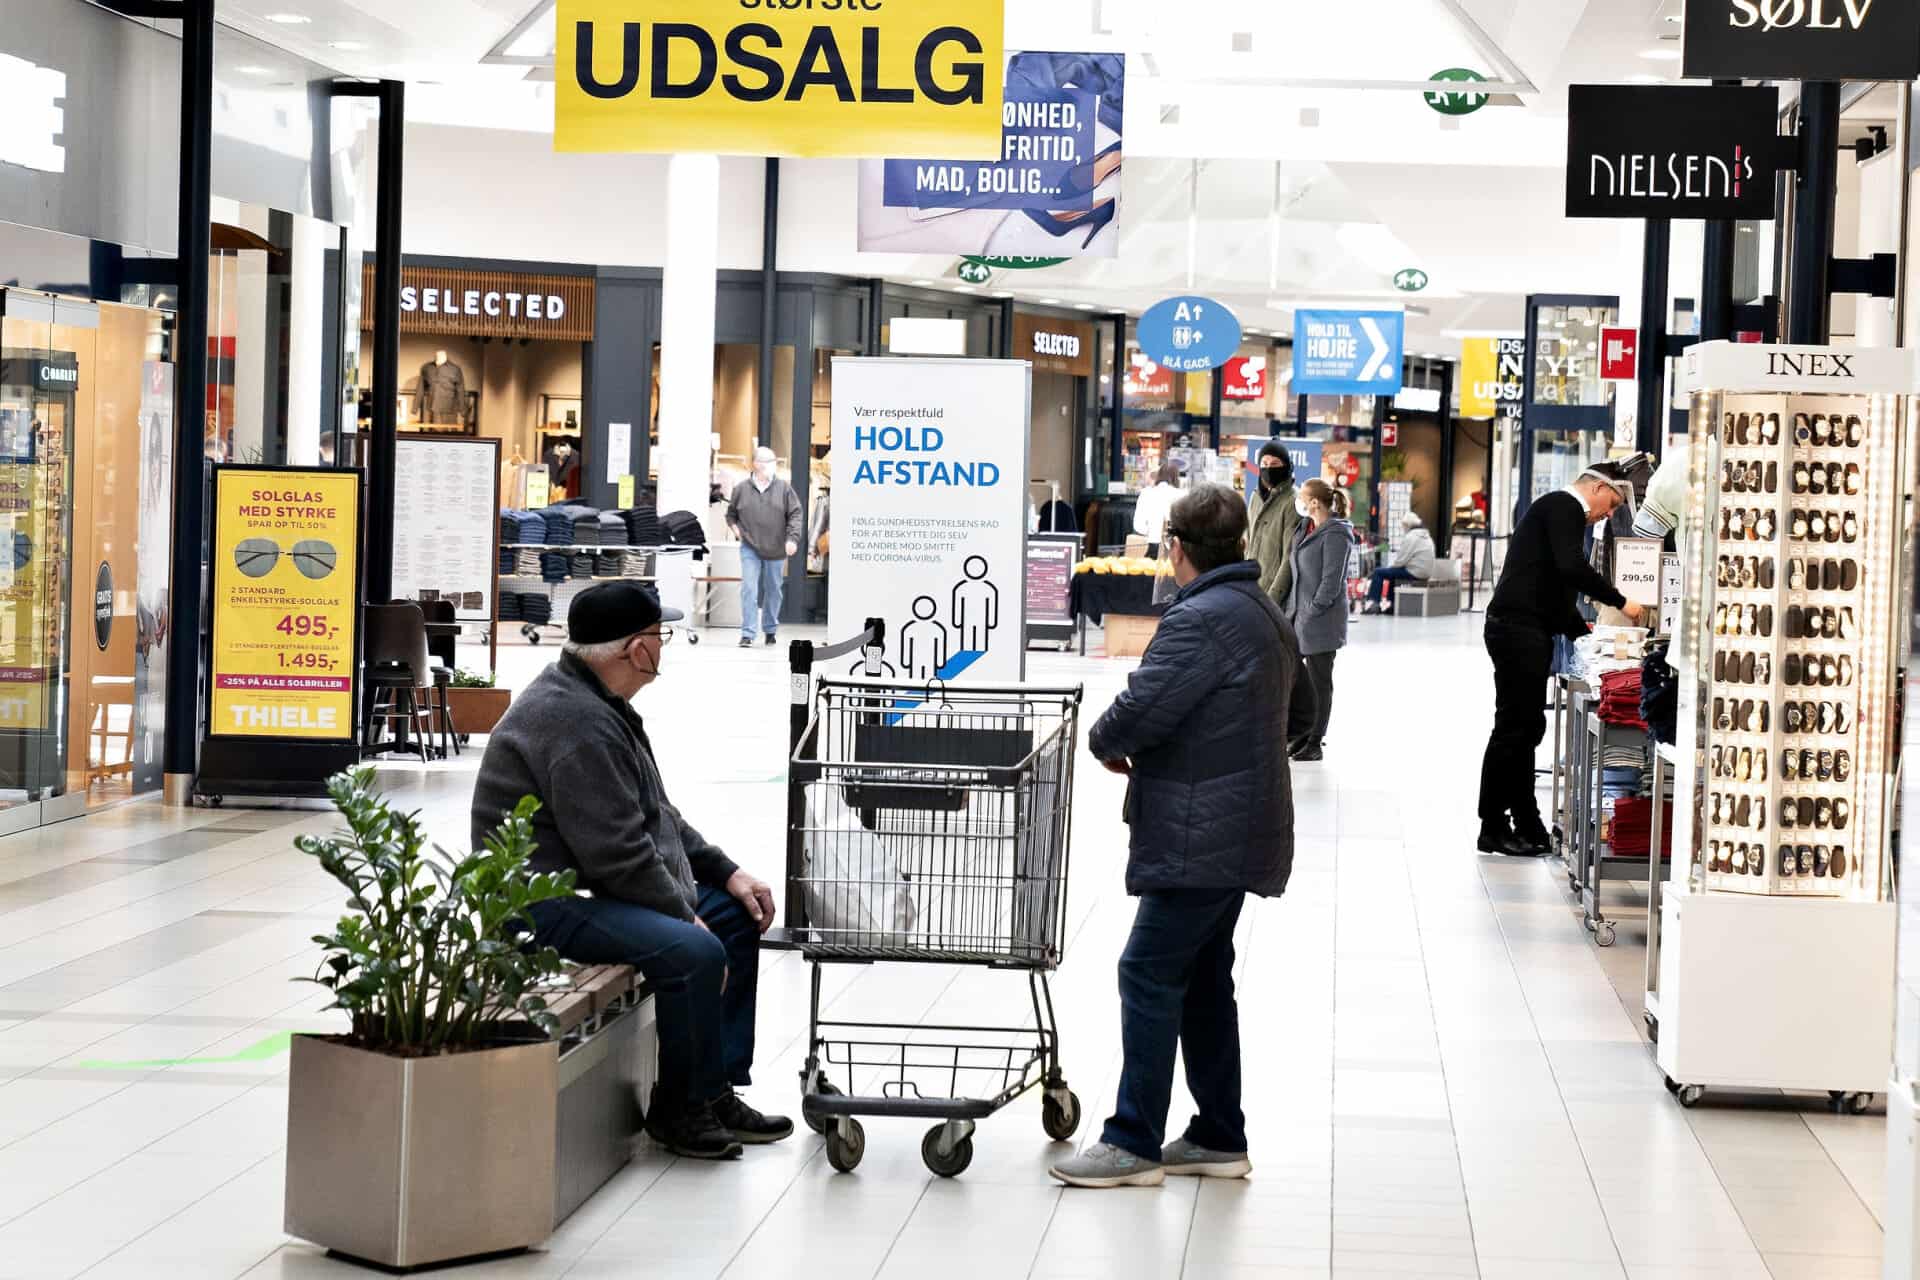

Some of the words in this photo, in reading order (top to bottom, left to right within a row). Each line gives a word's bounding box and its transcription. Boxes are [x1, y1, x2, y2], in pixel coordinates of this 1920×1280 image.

[1729, 0, 1872, 31] SØLV
[575, 21, 984, 105] UDSALG
[1003, 102, 1082, 131] ØNHED,
[1006, 135, 1081, 166] FRITID,
[916, 165, 971, 196] MAD,
[978, 167, 1061, 194] BOLIG...
[400, 286, 565, 319] SELECTED
[1174, 301, 1191, 321] A
[1033, 331, 1080, 358] SELECTED
[1183, 356, 1211, 370] GADE
[1766, 352, 1856, 377] INEX
[854, 406, 877, 417] Vær
[880, 407, 944, 420] respektfuld
[855, 426, 944, 451] HOLD
[853, 460, 1000, 487] AFSTAND
[252, 490, 323, 503] SOLGLAS
[239, 505, 271, 517] MED
[276, 506, 336, 518] STYRKE
[247, 520, 271, 528] SPAR
[275, 520, 288, 528] OP
[852, 517, 875, 526] FØLG
[877, 518, 979, 528] SUNDHEDSSTYRELSENS
[852, 529, 870, 537] FOR
[871, 530, 884, 538] AT
[884, 530, 928, 539] BESKYTTE
[930, 531, 947, 539] DIG
[948, 531, 968, 540] SELV
[852, 541, 865, 549] OG
[867, 542, 897, 550] ANDRE
[900, 543, 922, 551] MOD
[923, 543, 955, 551] SMITTE
[852, 553, 872, 561] MED
[1622, 574, 1655, 583] 299,50
[238, 587, 286, 595] STANDARD
[231, 596, 340, 606] ENKELTSTYRKE-SOLGLAS
[276, 615, 340, 640] 495,-
[278, 652, 339, 671] 1.495,-
[247, 676, 260, 686] PÅ
[262, 679, 286, 687] ALLE
[229, 704, 337, 729] THIELE
